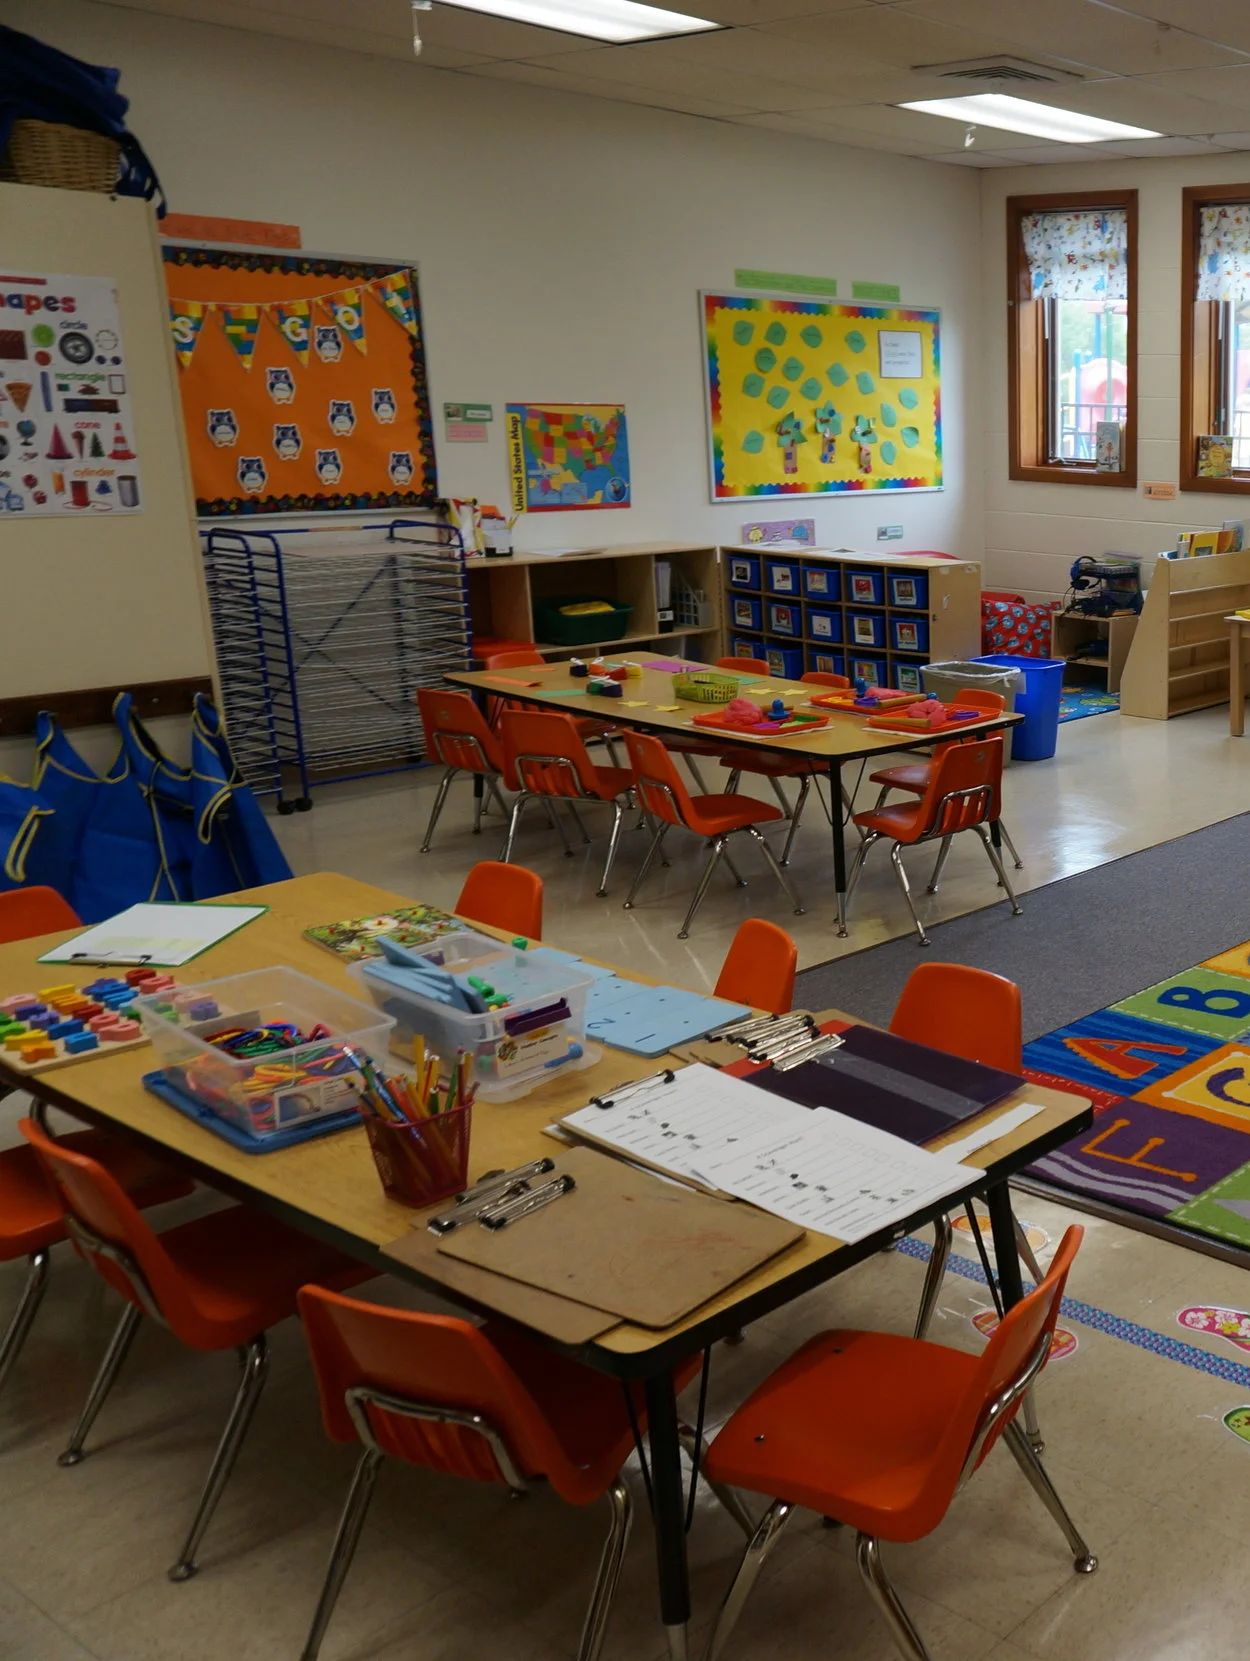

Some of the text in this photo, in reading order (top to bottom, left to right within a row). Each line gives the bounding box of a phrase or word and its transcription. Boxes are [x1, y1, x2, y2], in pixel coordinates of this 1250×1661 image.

[510, 415, 524, 512] United States Map
[1062, 1036, 1190, 1080] A
[1080, 1118, 1198, 1182] F
